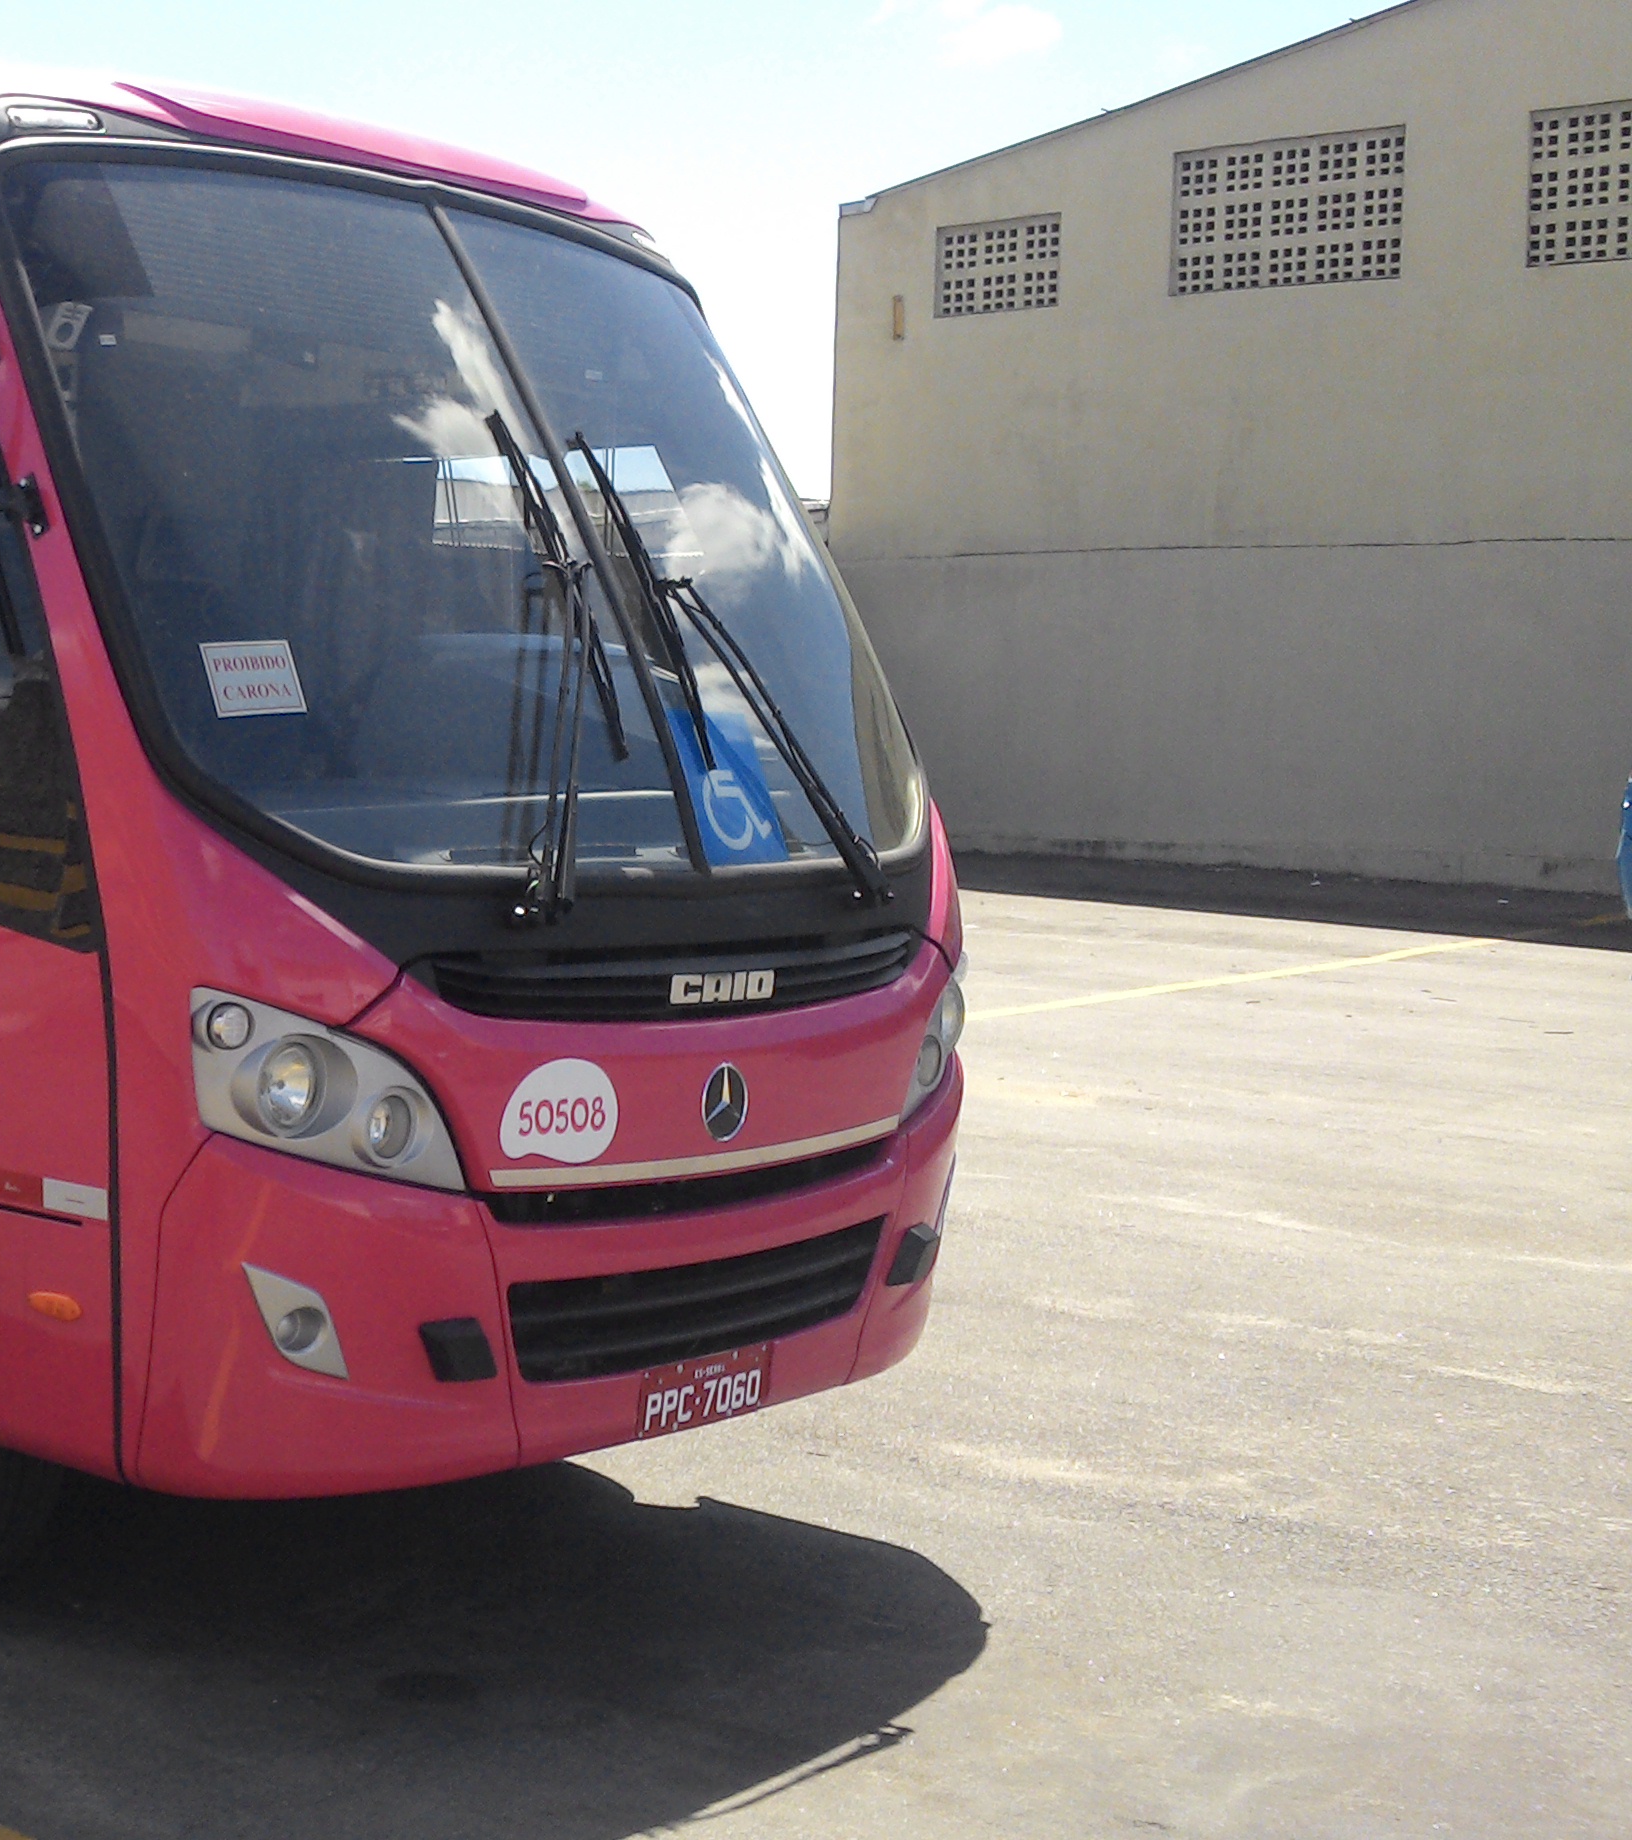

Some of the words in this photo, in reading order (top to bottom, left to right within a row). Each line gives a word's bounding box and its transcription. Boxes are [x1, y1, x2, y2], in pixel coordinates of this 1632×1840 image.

[212, 655, 287, 674] PROIBIDO
[222, 683, 293, 701] CARONA
[669, 969, 776, 1005] CAIO
[518, 1096, 607, 1137] 50508
